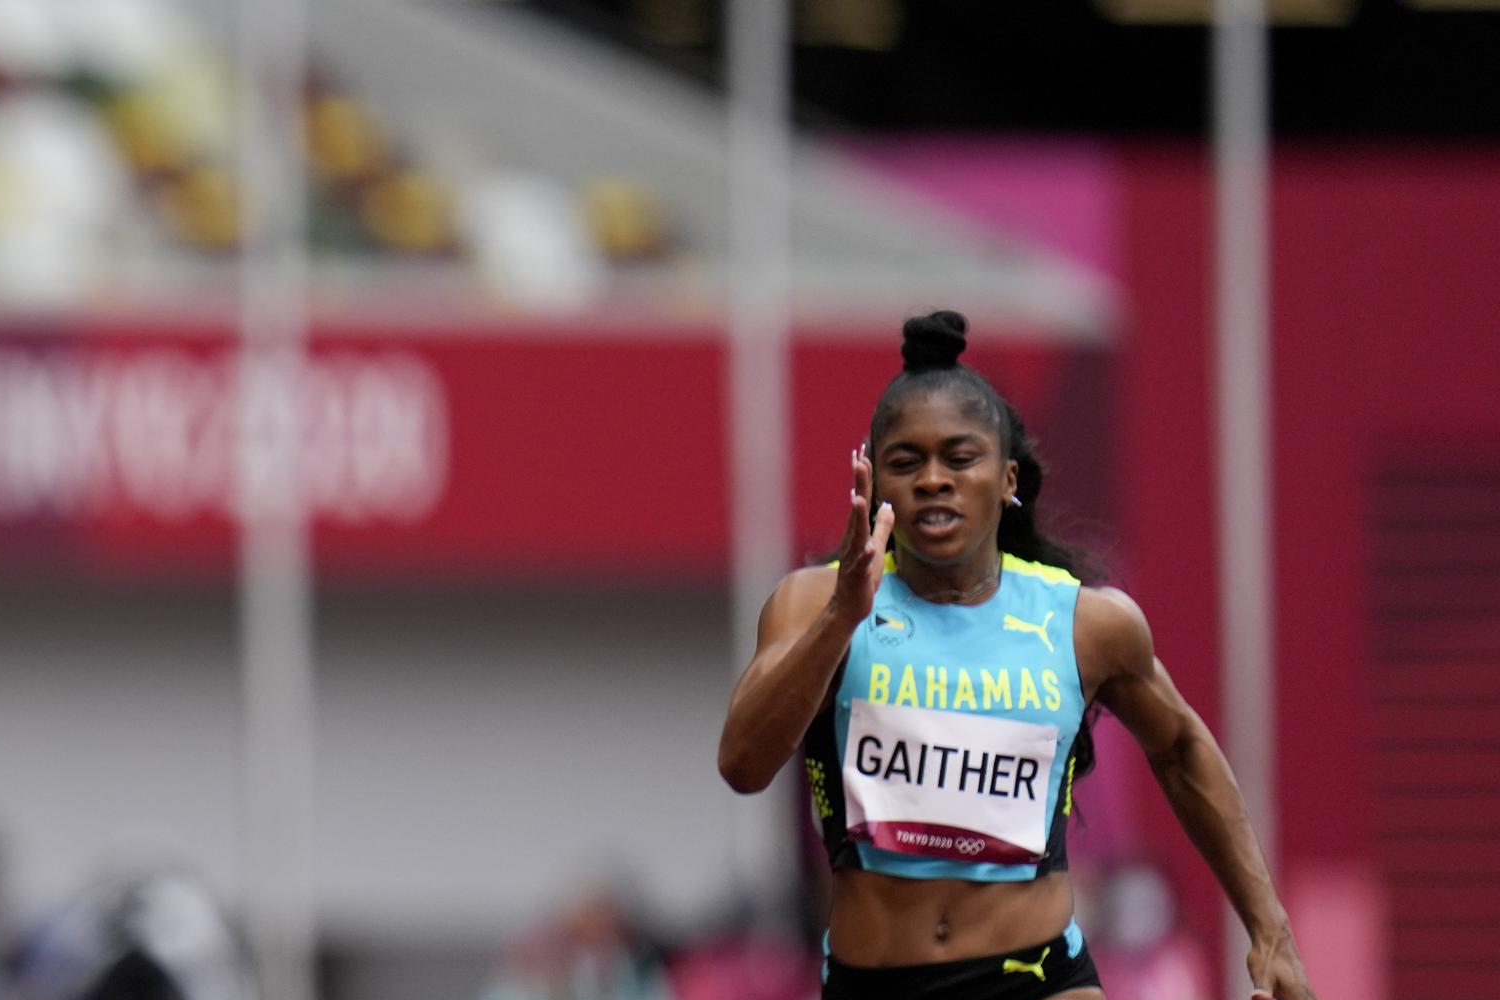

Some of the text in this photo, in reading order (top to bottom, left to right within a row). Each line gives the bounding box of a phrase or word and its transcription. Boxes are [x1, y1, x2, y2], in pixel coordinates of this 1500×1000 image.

[869, 664, 1061, 711] BAHAMAS
[856, 736, 1039, 801] GAITHER
[896, 829, 953, 850] TOKYO 2020
